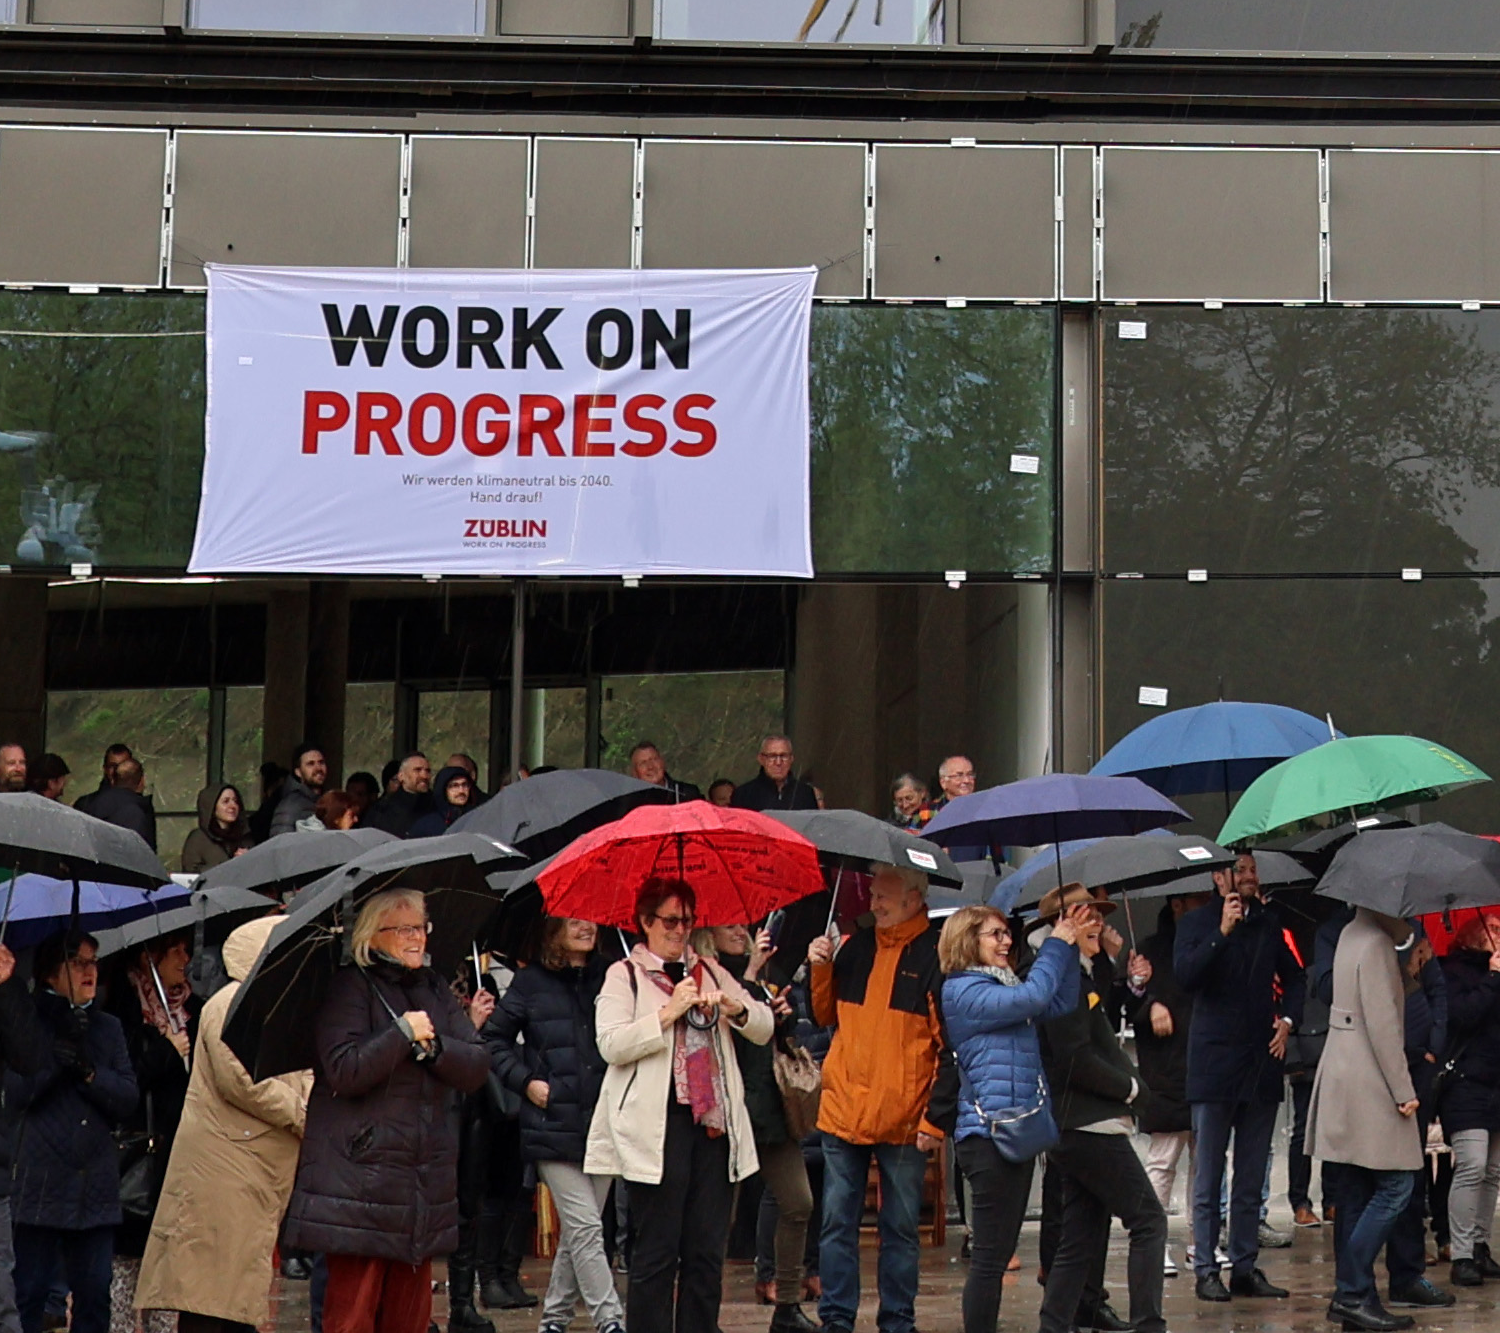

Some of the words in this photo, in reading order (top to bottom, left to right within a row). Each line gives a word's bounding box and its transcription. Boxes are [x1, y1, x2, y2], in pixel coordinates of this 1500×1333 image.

[322, 304, 564, 370] WORK
[586, 308, 691, 371] ON
[302, 391, 717, 457] PROGRESS
[402, 474, 424, 486] Wir
[427, 475, 473, 486] werden
[476, 475, 555, 486] klimaneutral
[559, 475, 577, 486] bis
[580, 475, 614, 486] 2040.
[470, 491, 501, 502] Hand
[505, 491, 543, 502] drauf!
[464, 519, 547, 538] ZÜBLIN
[505, 541, 547, 549] PROGRESS
